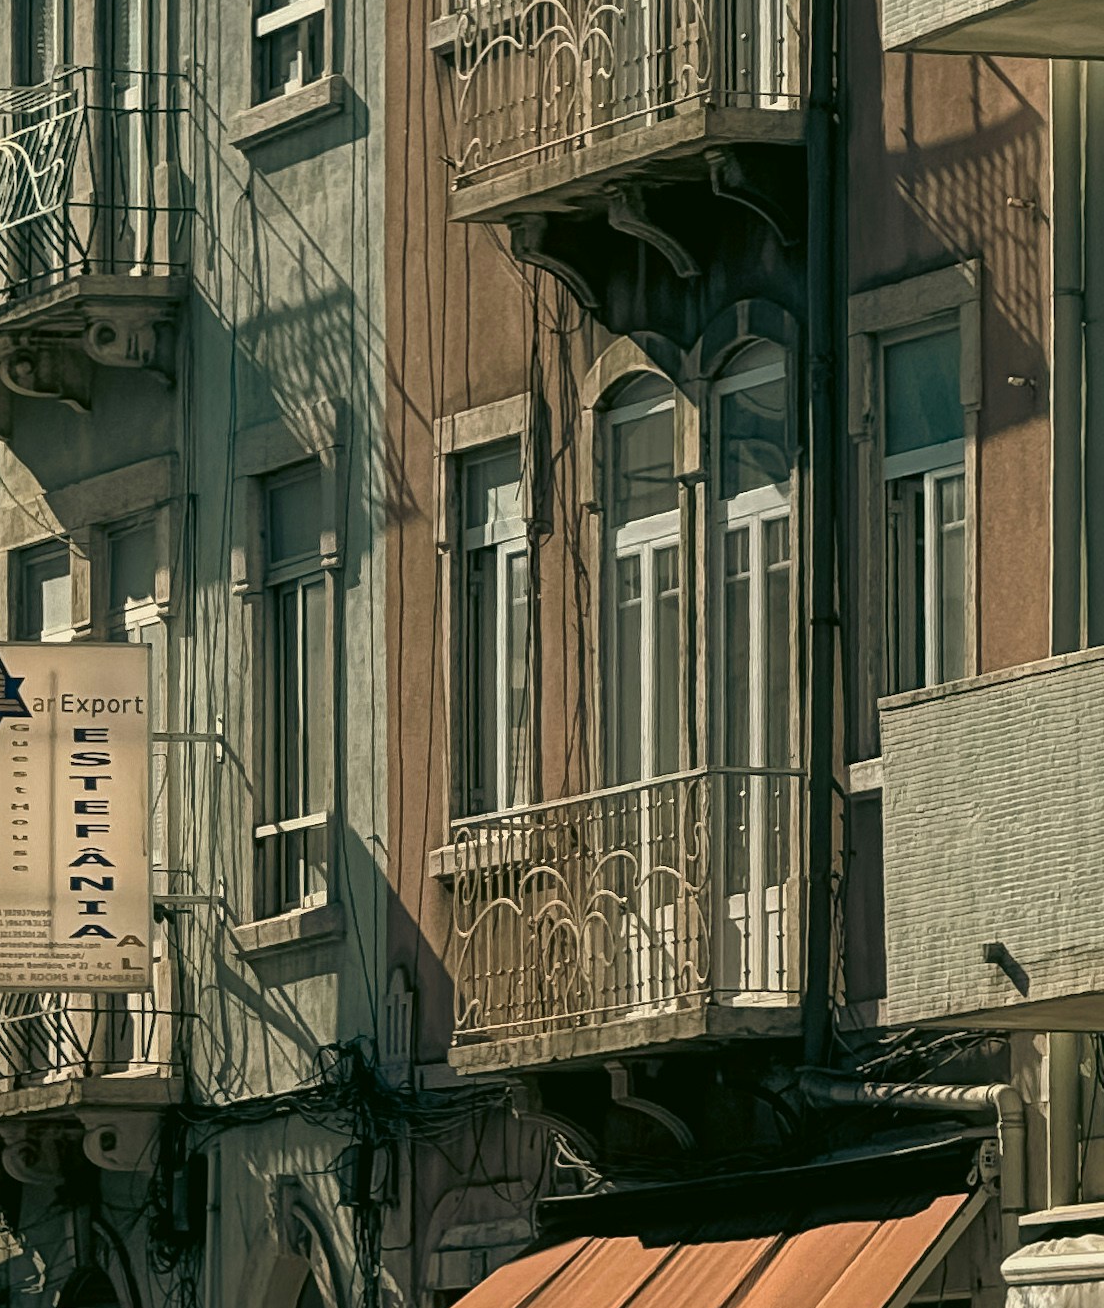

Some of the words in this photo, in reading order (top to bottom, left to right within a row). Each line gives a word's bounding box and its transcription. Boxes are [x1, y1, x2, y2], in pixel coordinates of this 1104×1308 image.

[61, 693, 145, 717] Export
[68, 727, 117, 939] ESTEFÂNIA
[30, 973, 68, 982] ROOMS
[86, 973, 146, 983] CHAMBRES
